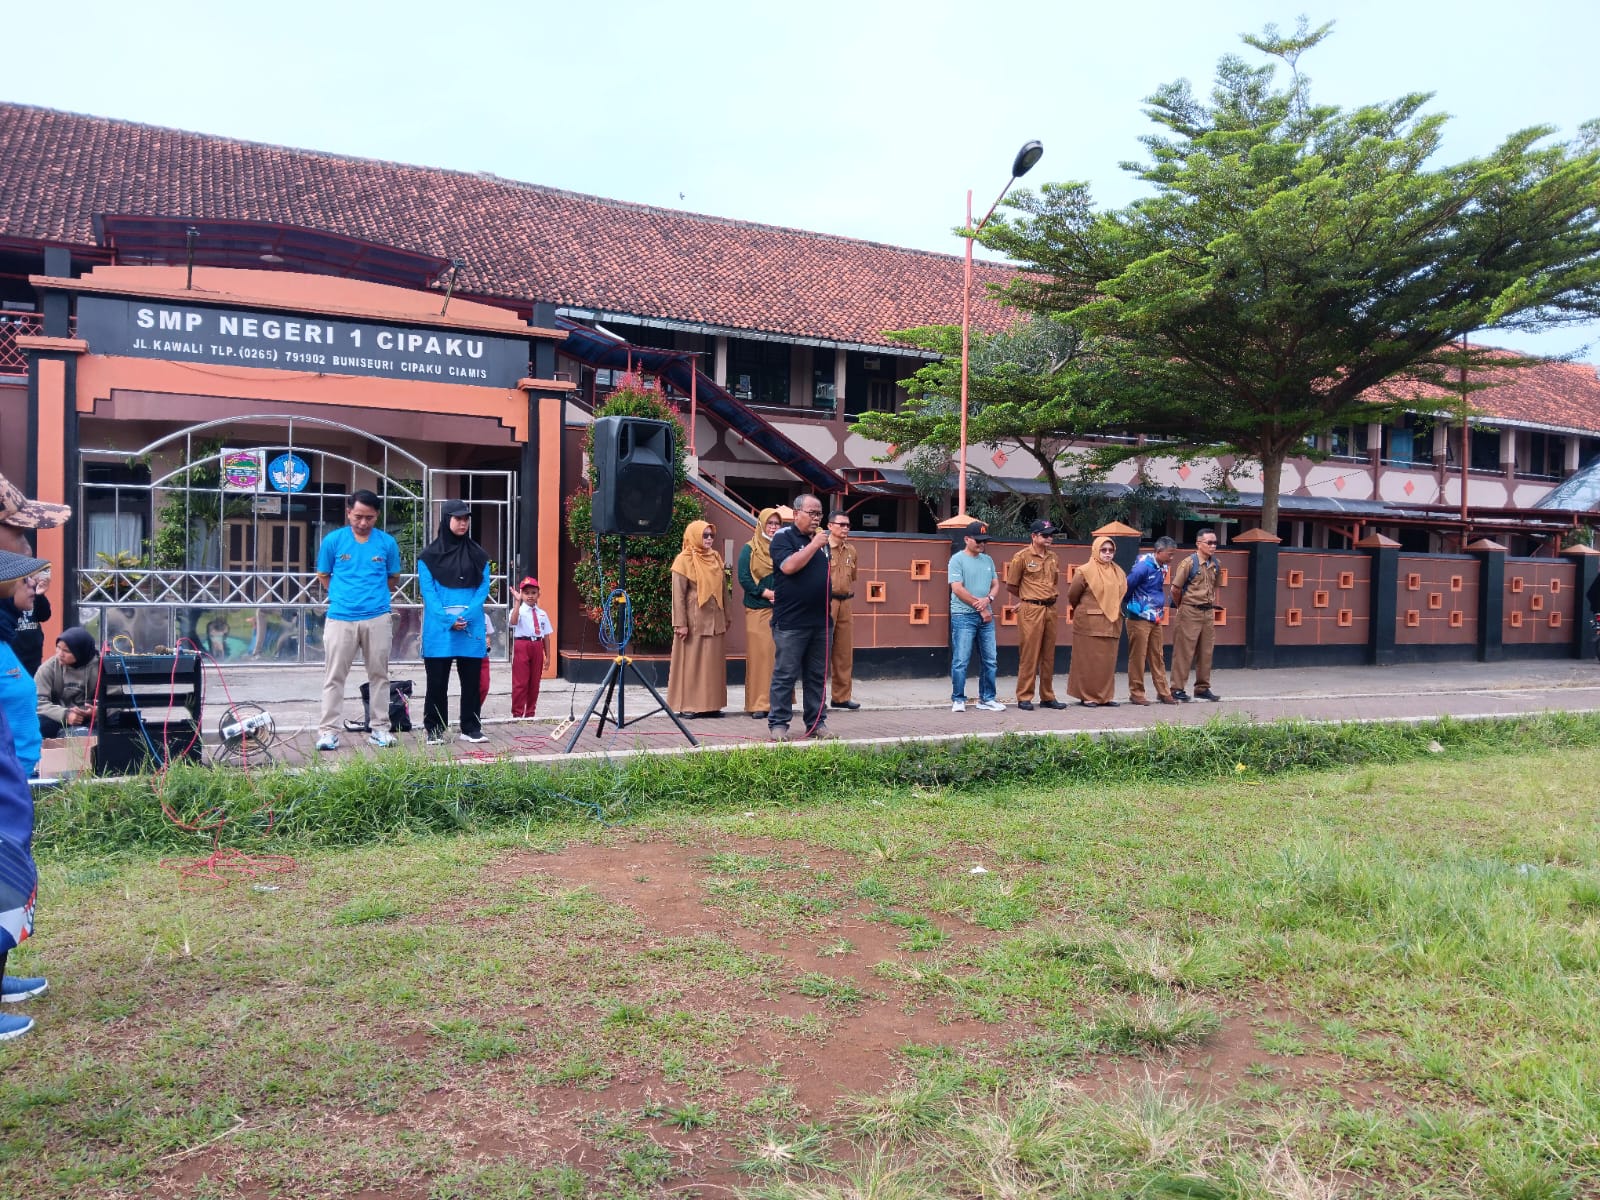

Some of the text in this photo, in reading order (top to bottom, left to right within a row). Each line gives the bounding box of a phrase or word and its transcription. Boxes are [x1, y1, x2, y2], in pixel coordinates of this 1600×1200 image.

[136, 308, 484, 359] SMP NEGERI 1 CIPAKU
[285, 351, 326, 365] 791902
[332, 355, 394, 371] BUNISEURI
[401, 361, 442, 375] CIPAKU
[448, 366, 487, 379] CIAMIS
